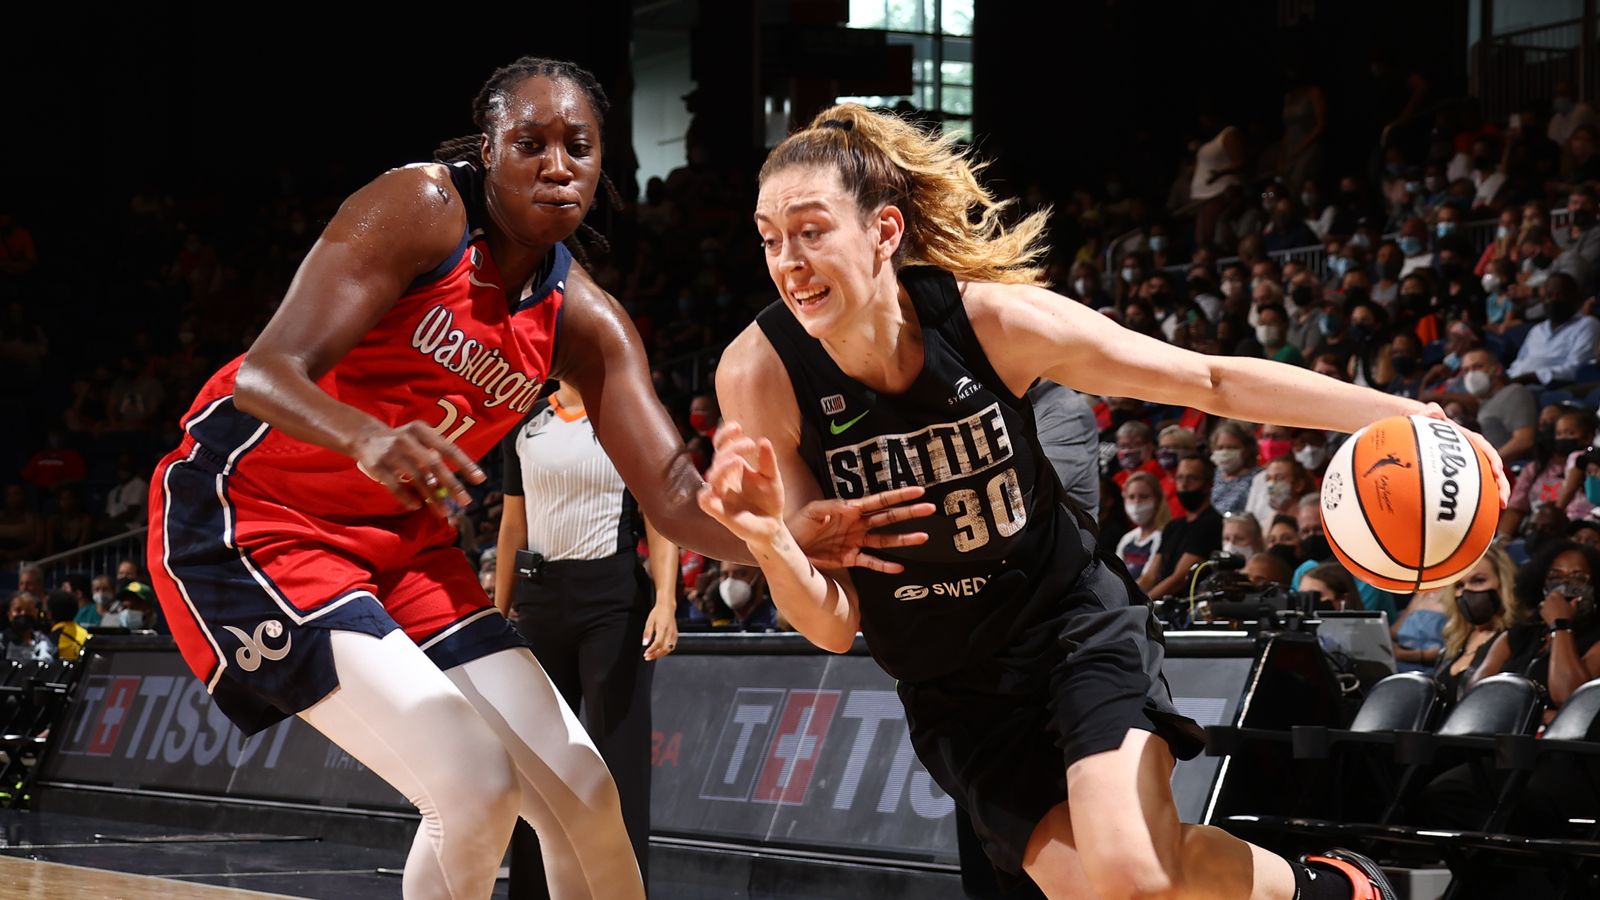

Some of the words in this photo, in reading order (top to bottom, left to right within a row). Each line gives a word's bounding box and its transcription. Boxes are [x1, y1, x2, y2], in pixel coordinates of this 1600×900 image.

[412, 304, 543, 413] Washingto
[828, 406, 1011, 500] SEATTLE
[1428, 422, 1467, 522] Wilson
[944, 468, 1027, 553] 30
[932, 574, 992, 598] SWED
